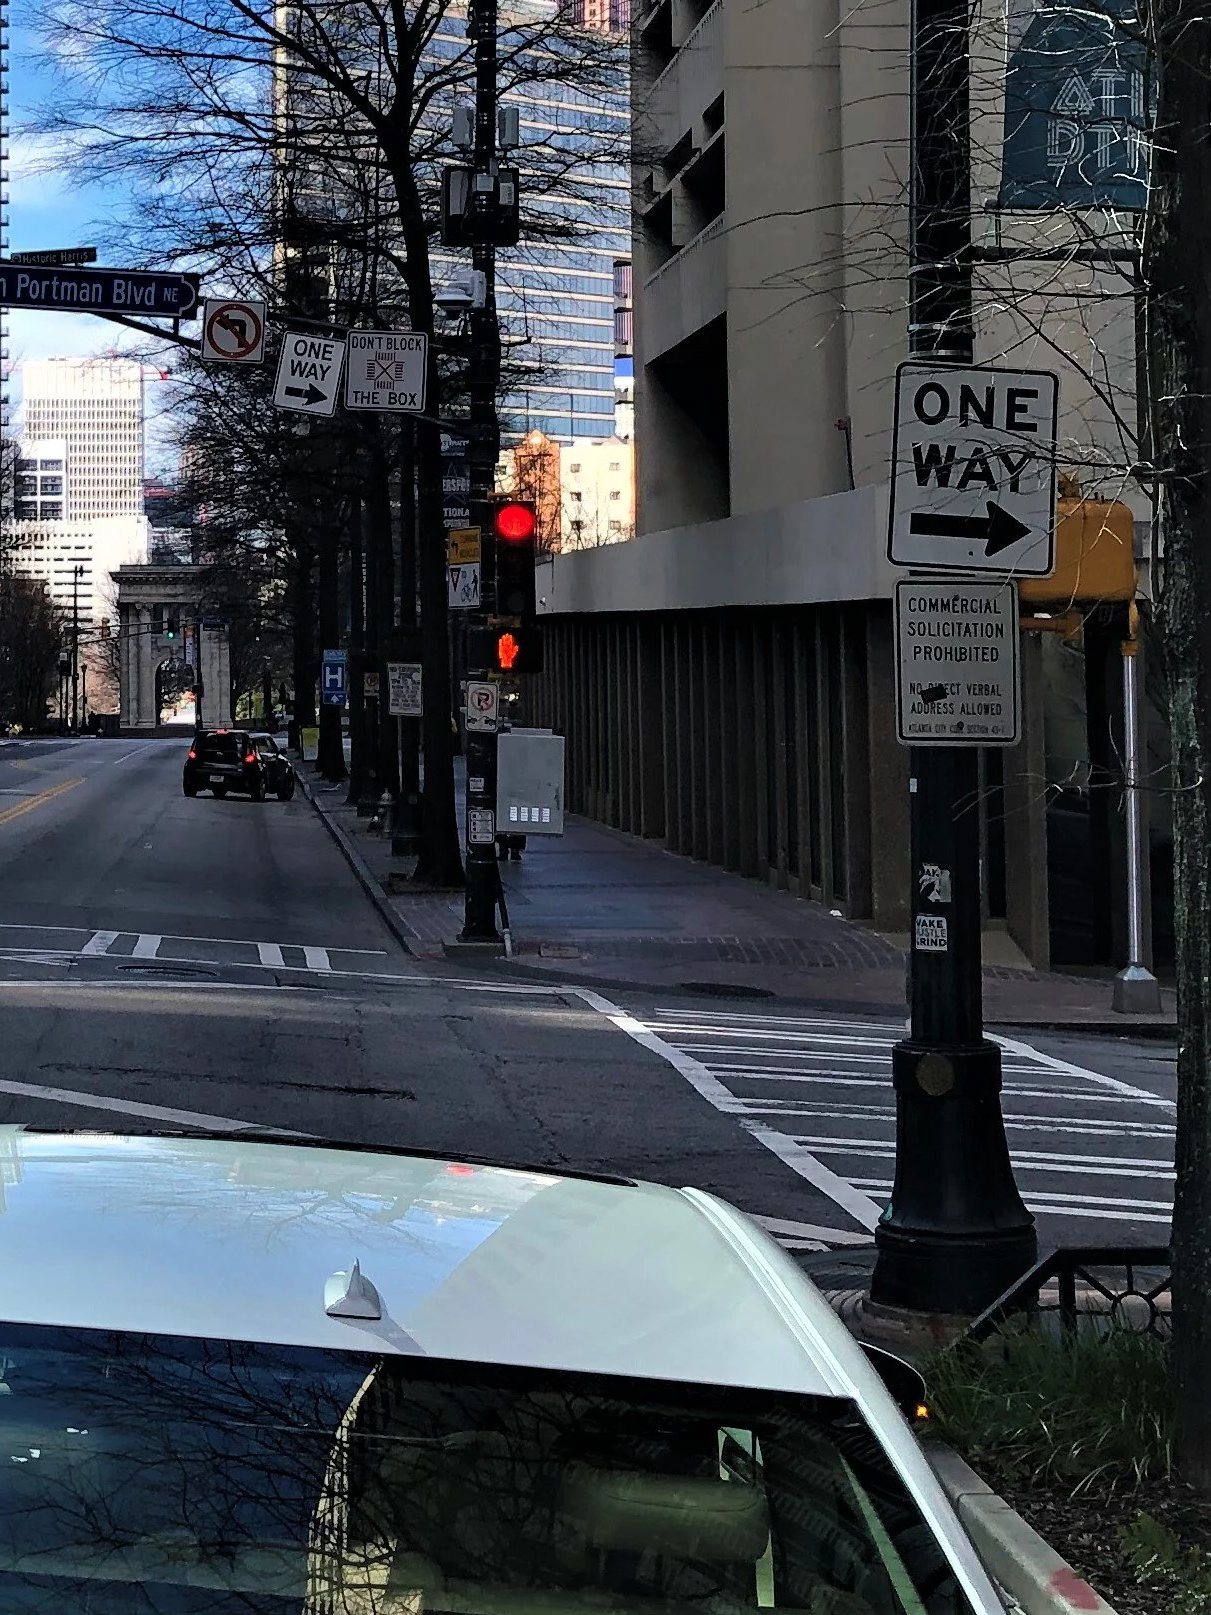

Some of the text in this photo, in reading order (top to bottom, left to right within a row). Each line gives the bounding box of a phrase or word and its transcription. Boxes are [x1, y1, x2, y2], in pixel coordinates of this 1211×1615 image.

[22, 251, 89, 264] Historic Harris
[16, 274, 103, 303] Portman
[112, 279, 156, 306] Blvd
[163, 288, 179, 303] NE
[293, 339, 334, 361] ONE
[352, 336, 422, 351] DON'T BLOCK
[290, 359, 332, 381] WAY
[353, 391, 418, 406] THE BOX
[914, 382, 1039, 432] ONE
[912, 442, 1037, 493] WAY
[908, 597, 1002, 614] COMMERCIAL
[908, 621, 1004, 639] SOLICITATION
[913, 646, 999, 662] PROHIBITED
[909, 683, 922, 695] NO
[966, 684, 1002, 696] VERBAL
[911, 702, 1002, 716] ADDRESS ALLOWED
[916, 938, 947, 947] RIND
